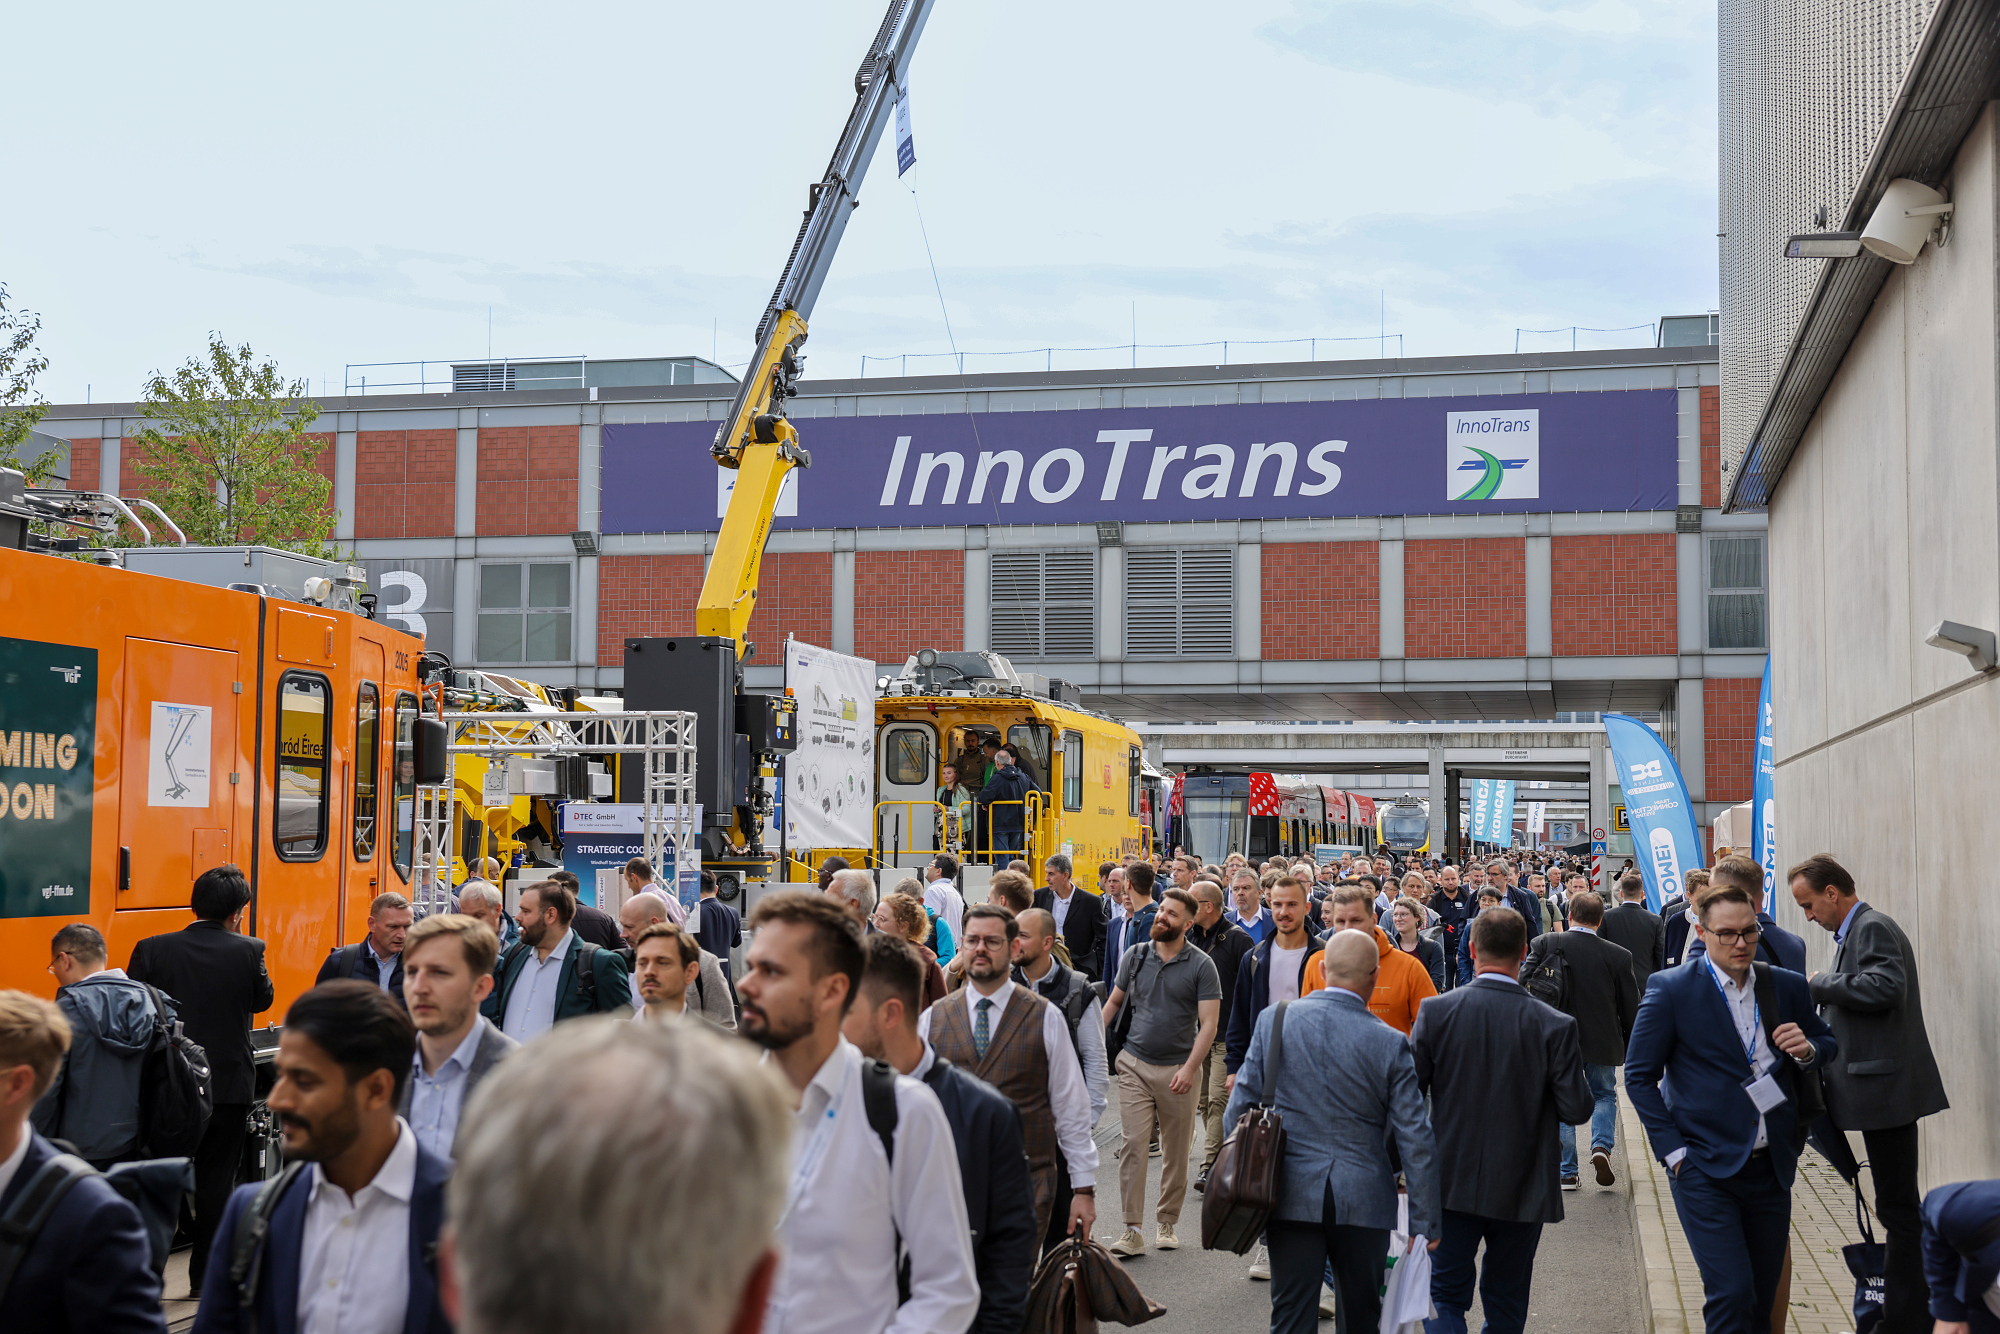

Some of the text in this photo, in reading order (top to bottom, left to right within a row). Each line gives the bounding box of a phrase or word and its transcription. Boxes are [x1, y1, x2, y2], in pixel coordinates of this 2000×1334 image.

[1456, 417, 1530, 434] InnoTrans
[879, 428, 1348, 506] InnoTrans
[379, 570, 428, 641] 3
[395, 650, 409, 672] 2005
[573, 812, 616, 821] DTEC GmbH
[1595, 830, 1603, 838] 20
[577, 845, 625, 854] STRATEGIC
